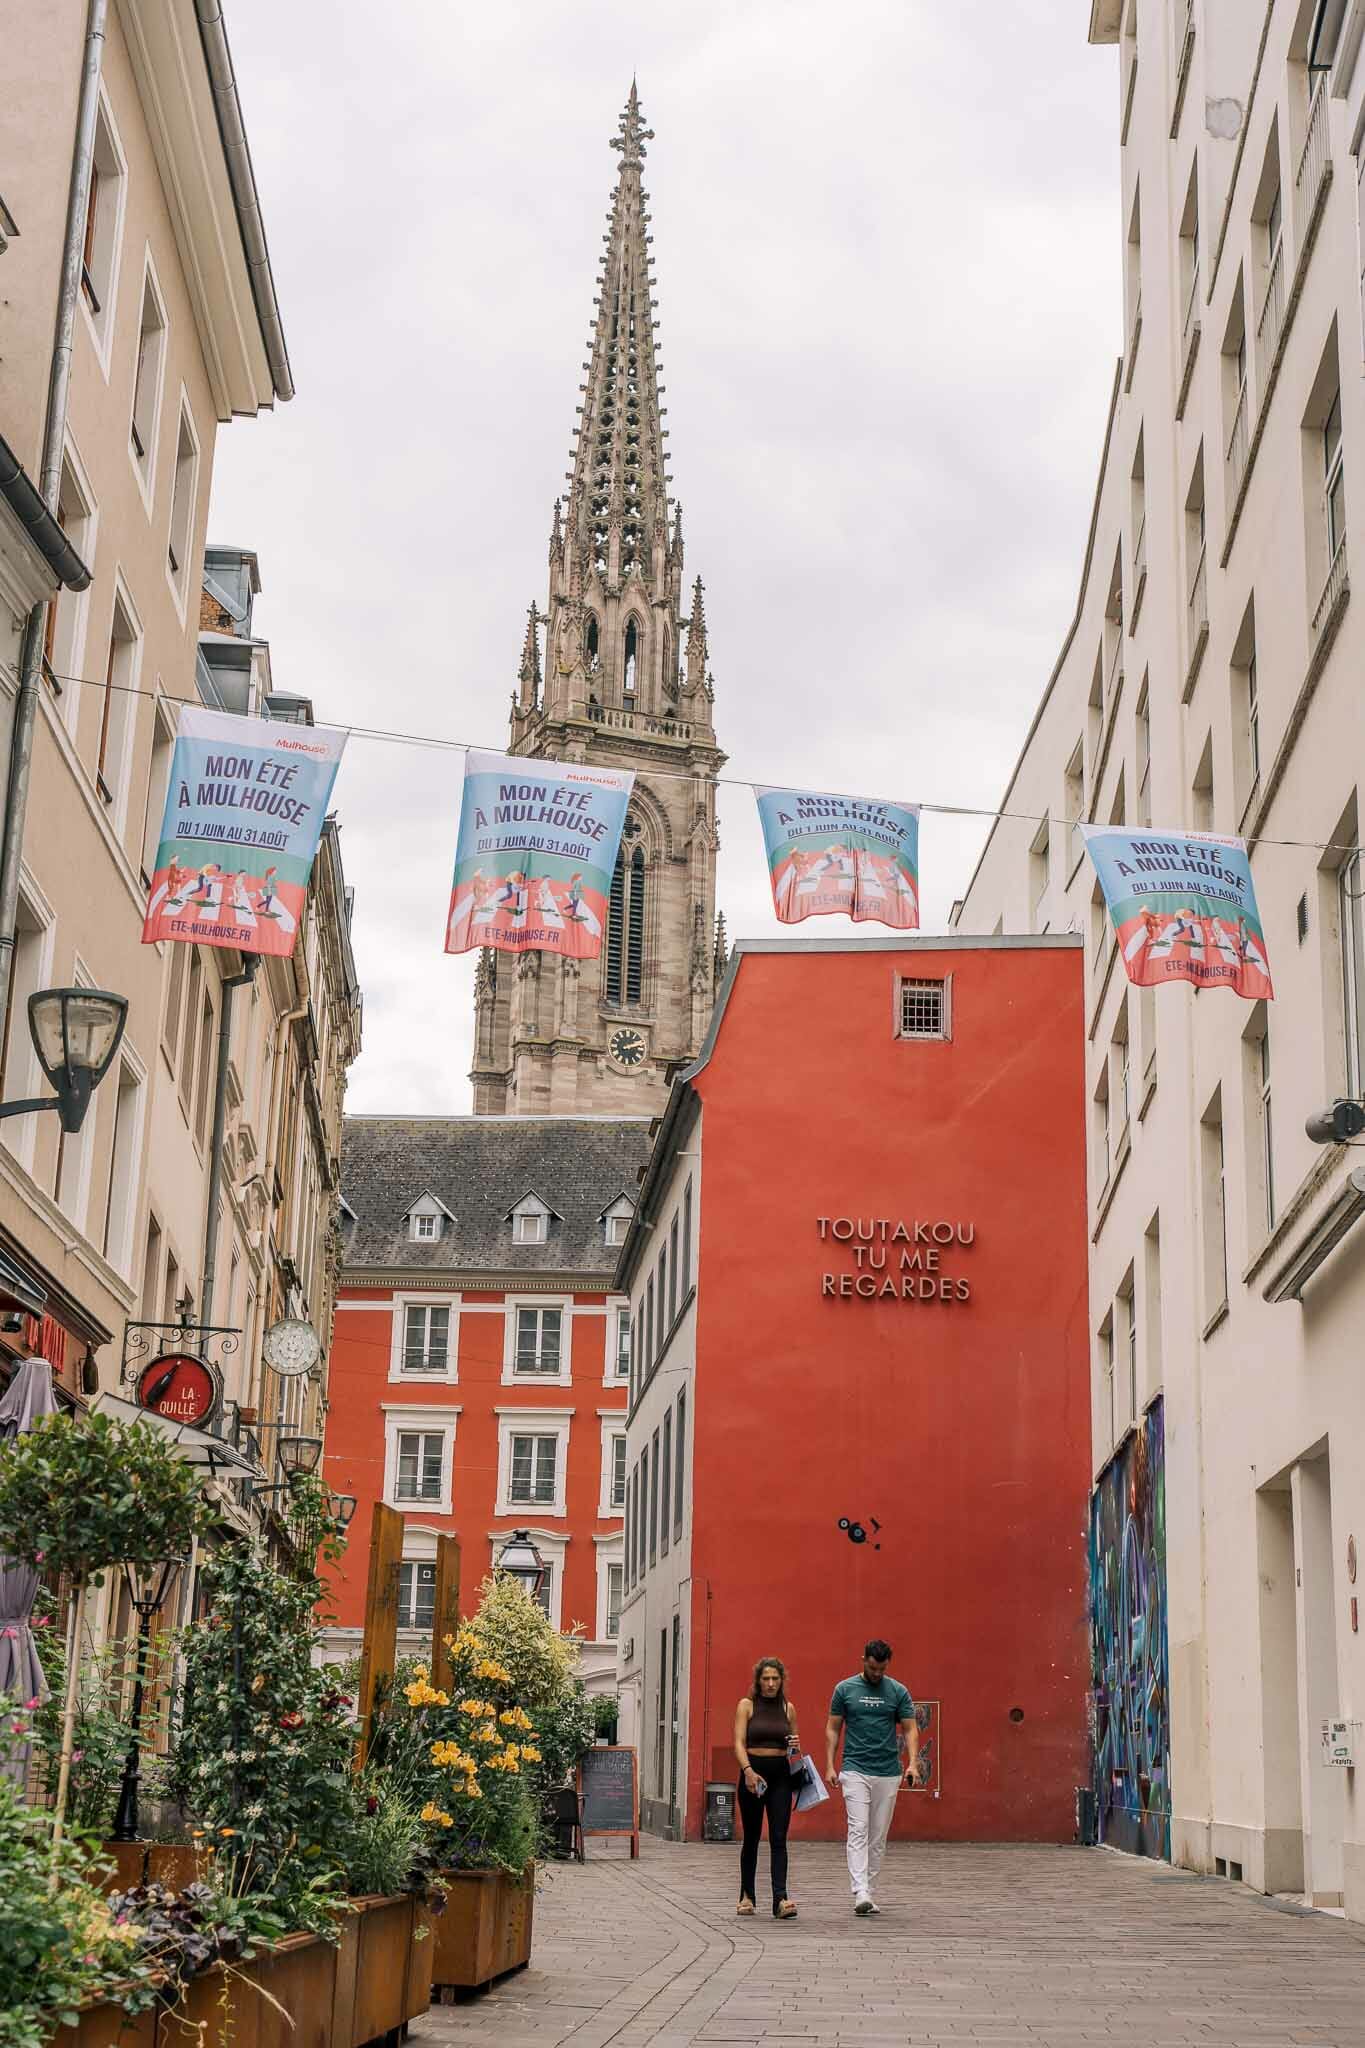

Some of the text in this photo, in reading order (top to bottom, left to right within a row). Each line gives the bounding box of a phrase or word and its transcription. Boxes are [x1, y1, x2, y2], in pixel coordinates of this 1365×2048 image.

[275, 738, 329, 755] Mulhouse
[205, 755, 299, 790] MON ÉTÉ
[178, 781, 311, 826] À MULHOUSE
[499, 784, 593, 811] MON ÉTÉ
[797, 797, 845, 809] MON
[177, 821, 290, 847] DU 1 JUIN AU 31 AOÛT
[474, 805, 609, 842] À MULHOUSE
[787, 828, 803, 838] DU
[797, 808, 911, 841] MULHOUSE
[477, 835, 592, 858] DU 1 JUIN AU 31 AOÛT
[1130, 842, 1223, 864] MON ÉTÉ
[1113, 857, 1248, 893] À MULHOUSE
[1132, 883, 1148, 893] DU
[1158, 881, 1184, 891] JUIN
[1186, 881, 1201, 891] AU
[170, 920, 251, 942] ETE-MULHOUSE.FR
[816, 1217, 976, 1246] TOUTAKOU
[852, 1246, 941, 1272] TU ME
[821, 1273, 971, 1300] REGARDES
[182, 1387, 195, 1400] LA
[160, 1401, 196, 1415] QUILLE
